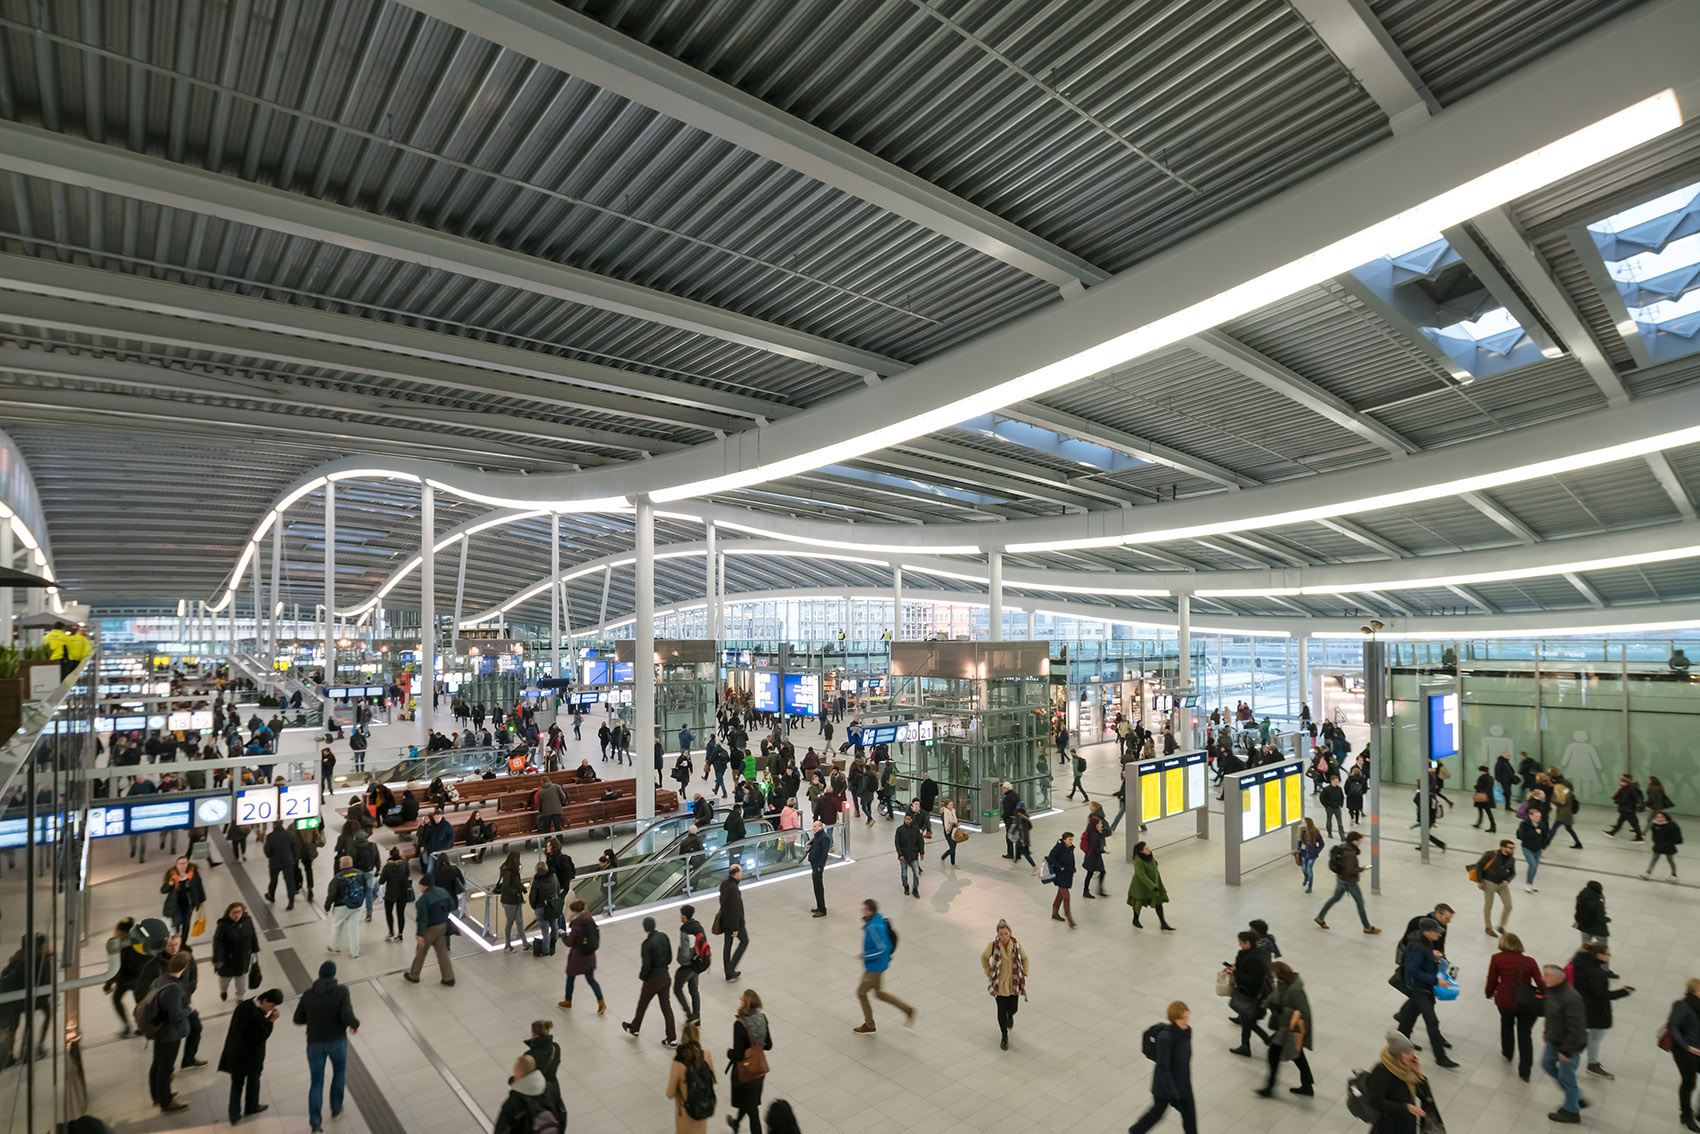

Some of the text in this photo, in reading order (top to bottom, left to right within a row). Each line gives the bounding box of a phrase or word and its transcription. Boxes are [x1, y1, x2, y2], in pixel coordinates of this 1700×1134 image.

[907, 728, 917, 740] 20
[921, 727, 931, 738] 21
[242, 801, 272, 821] 20
[285, 797, 311, 816] 21
[109, 813, 122, 821] 20
[109, 826, 122, 834] 21
